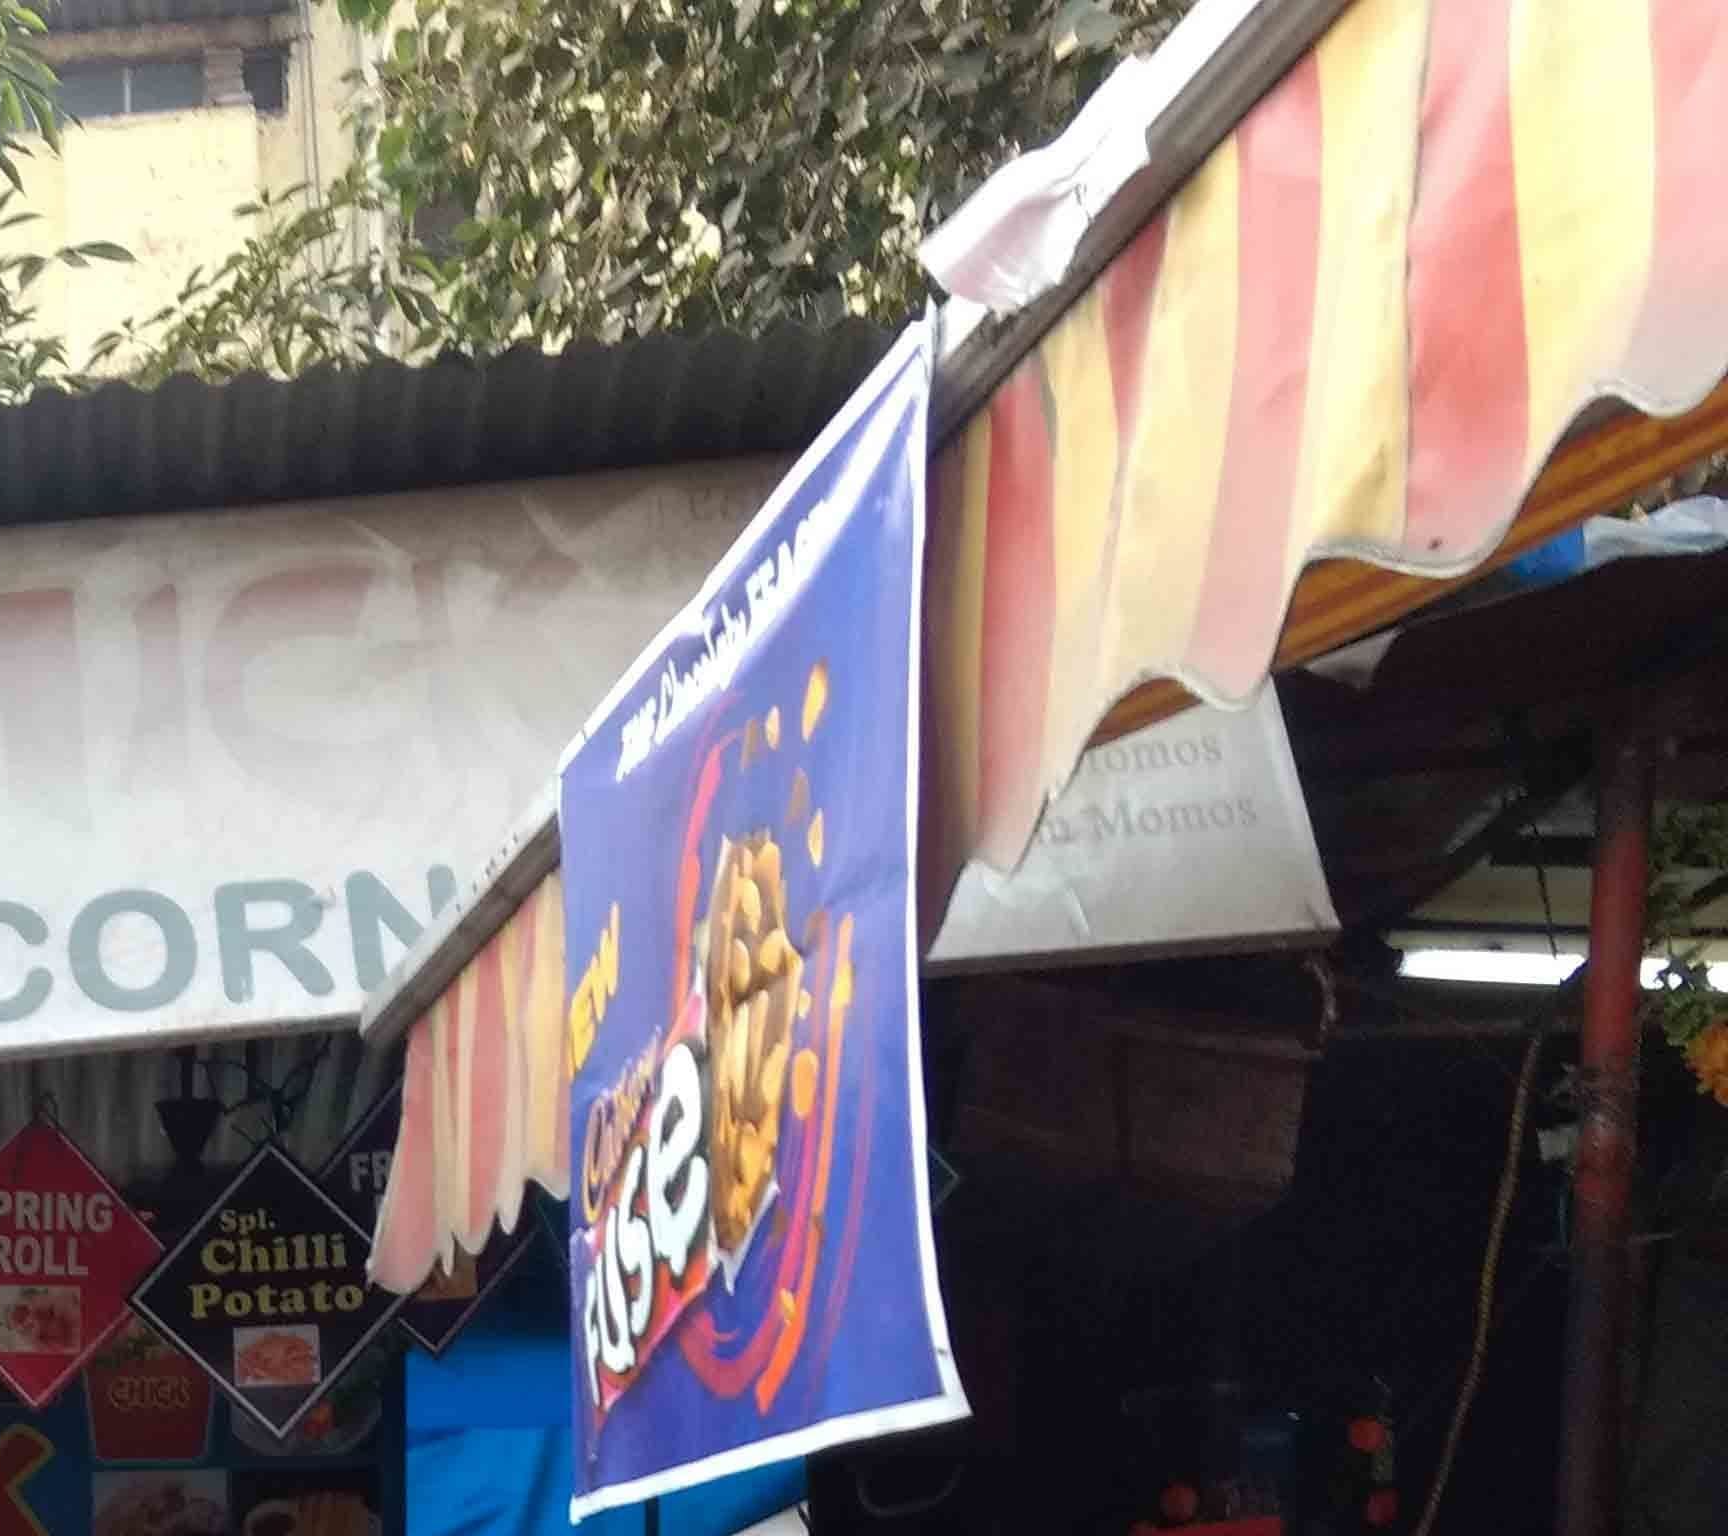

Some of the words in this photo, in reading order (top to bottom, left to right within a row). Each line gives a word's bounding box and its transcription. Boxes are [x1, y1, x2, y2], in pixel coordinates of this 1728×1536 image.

[1081, 798, 1257, 840] Momos
[201, 1232, 347, 1275] Chilli
[191, 1278, 363, 1320] Potato
